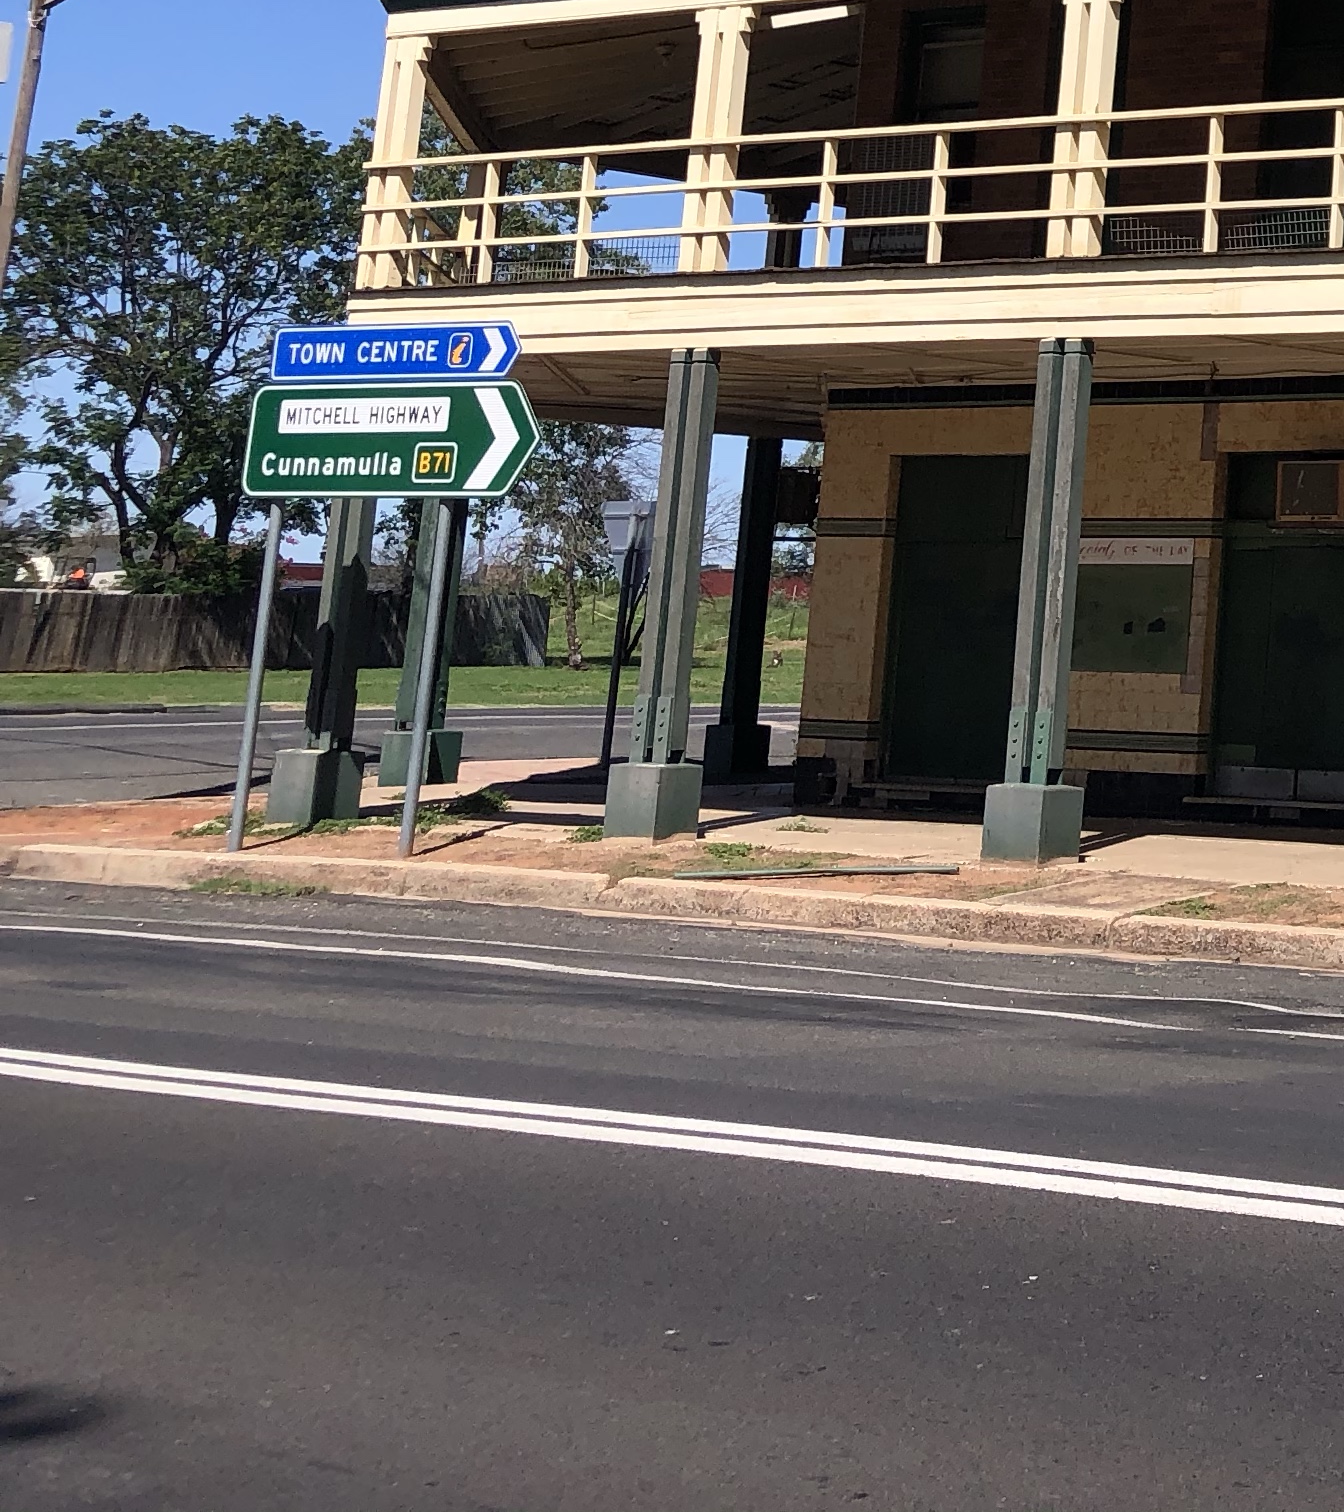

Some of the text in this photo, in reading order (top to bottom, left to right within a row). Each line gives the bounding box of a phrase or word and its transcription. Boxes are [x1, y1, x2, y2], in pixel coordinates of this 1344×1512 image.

[289, 340, 439, 364] TOWN CENTRE
[286, 404, 443, 425] MITCHELL HIGHWAY
[261, 452, 451, 476] Cunnamulla B71
